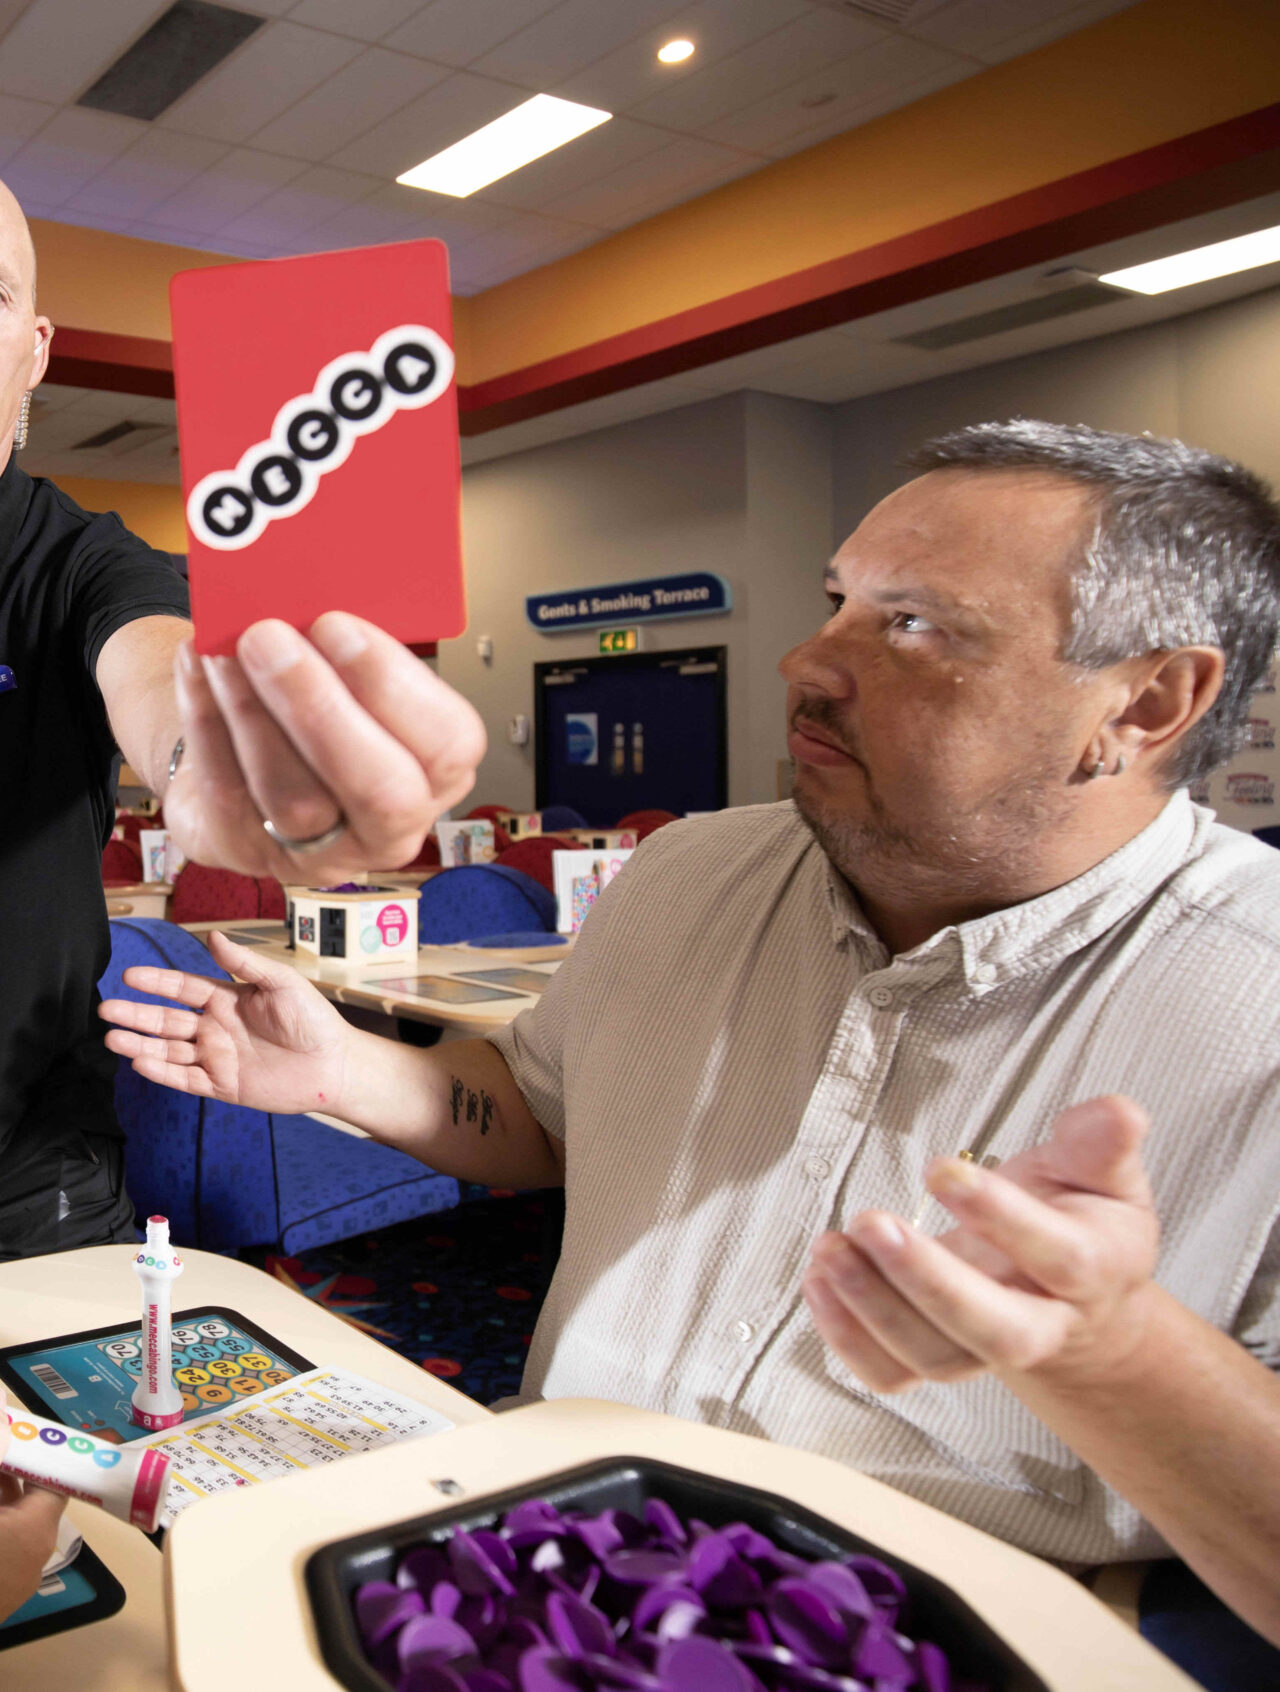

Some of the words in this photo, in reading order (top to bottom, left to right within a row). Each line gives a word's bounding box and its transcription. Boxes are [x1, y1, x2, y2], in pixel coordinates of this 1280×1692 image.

[200, 340, 438, 540] MECCA
[538, 603, 575, 621] Gents
[578, 599, 588, 615] &
[591, 592, 651, 614] Smoking
[653, 586, 710, 606] Terrace
[202, 1324, 224, 1337] 78
[172, 1331, 195, 1344] 76
[111, 1343, 133, 1357] 70
[148, 1303, 158, 1394] www.meccabingo.com
[223, 1339, 245, 1352] 55
[191, 1346, 215, 1359] 52
[242, 1355, 267, 1368] 37
[212, 1362, 237, 1376] 30
[180, 1369, 205, 1383] 24
[234, 1379, 257, 1392] 11
[206, 1389, 223, 1398] 9
[7, 1415, 122, 1469] ECCA
[310, 1448, 322, 1456] 23
